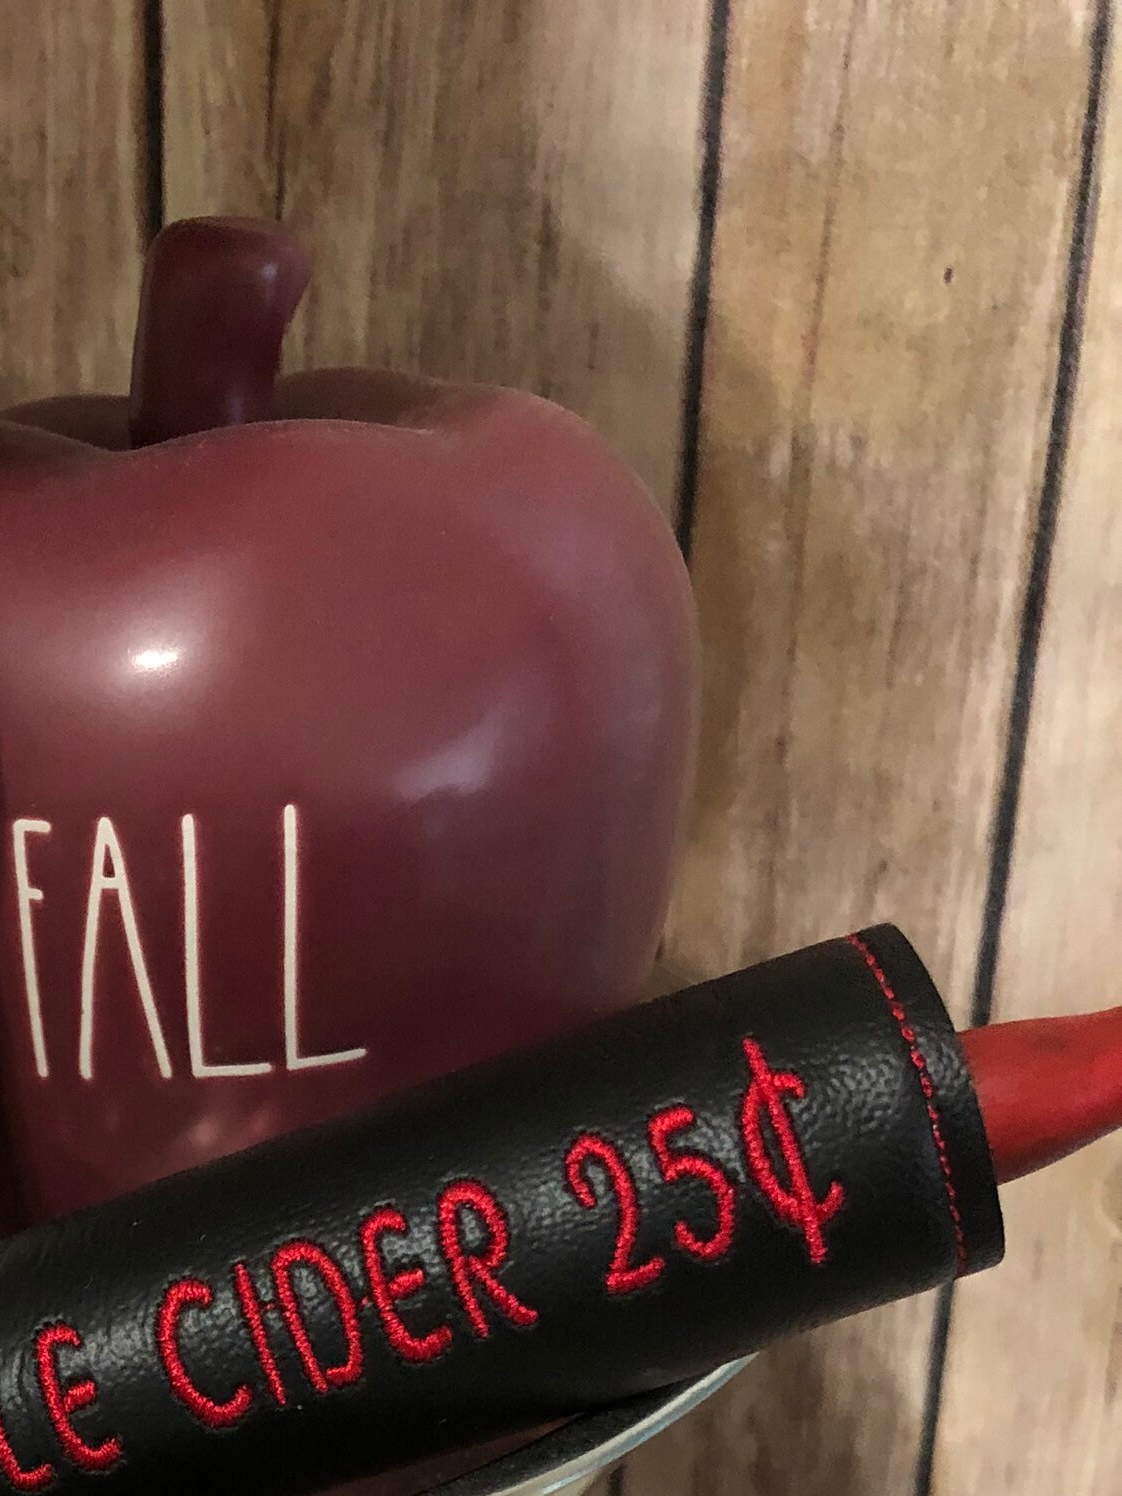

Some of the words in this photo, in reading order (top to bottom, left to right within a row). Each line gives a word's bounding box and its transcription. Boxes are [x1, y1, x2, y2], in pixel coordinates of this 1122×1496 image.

[13, 804, 367, 1080] FALL
[157, 1179, 540, 1425] CIDER
[564, 1034, 844, 1291] 25¢
